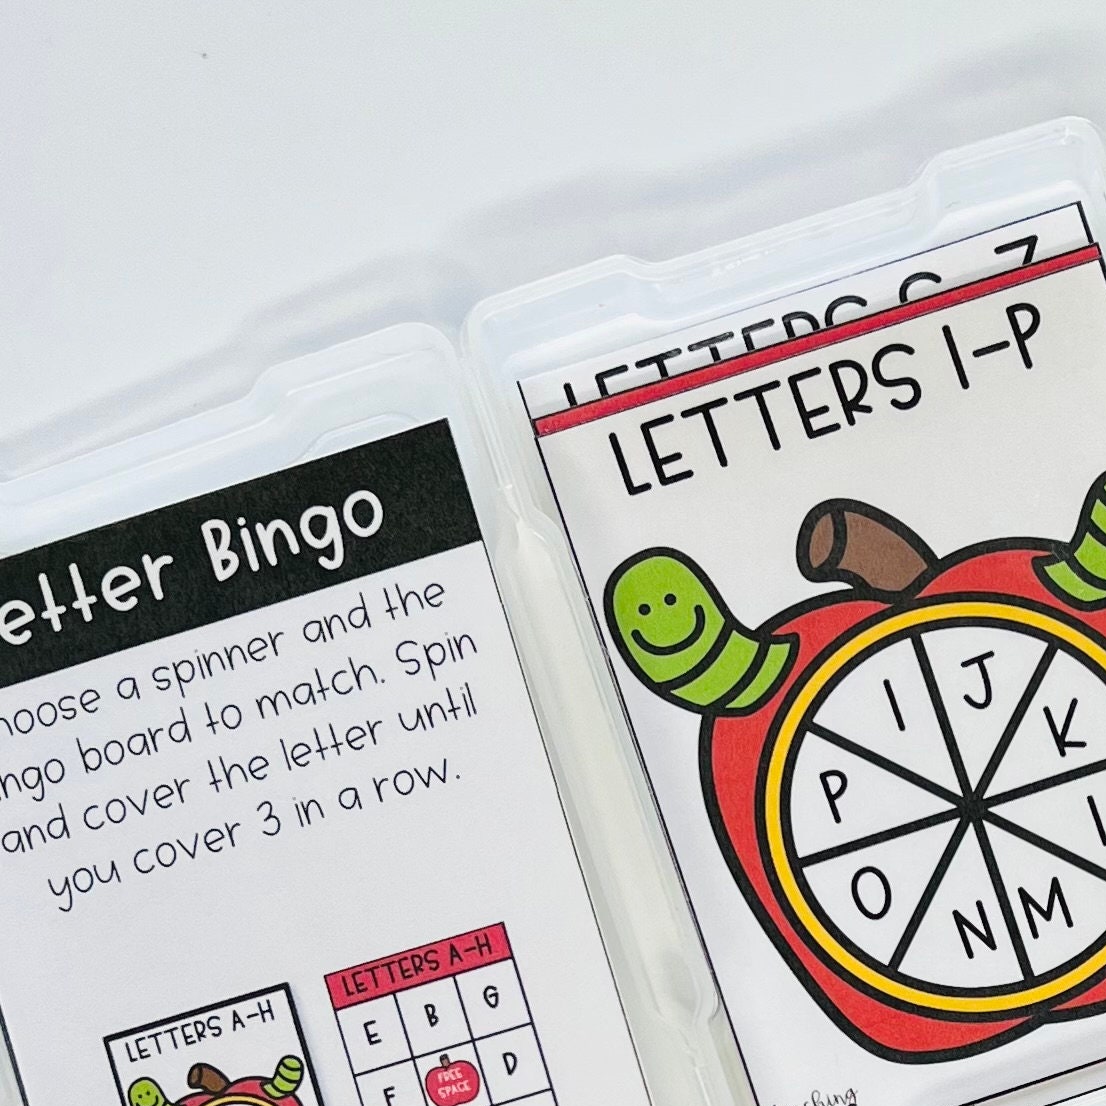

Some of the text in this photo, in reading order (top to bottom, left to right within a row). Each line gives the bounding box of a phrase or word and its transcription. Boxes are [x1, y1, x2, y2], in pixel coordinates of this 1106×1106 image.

[609, 343, 922, 497] LETTERS
[0, 489, 384, 645] etter Bingo
[117, 677, 141, 700] a
[152, 630, 285, 698] spinner
[303, 592, 372, 643] and
[384, 579, 445, 621] the
[884, 678, 906, 732] I
[960, 650, 995, 710] J
[0, 629, 478, 802] ngo board to match. Spin
[1043, 697, 1087, 758] K
[2, 682, 478, 853] and cover the letter until
[819, 769, 848, 824] P
[48, 757, 462, 913] you cover 3 in a row.
[850, 865, 892, 921] O
[1017, 876, 1074, 940] M
[952, 899, 998, 960] N
[342, 932, 493, 997] LETTERS A-H
[424, 1003, 439, 1029] B
[483, 985, 499, 1009] G
[125, 999, 275, 1063] LETTERS A-H
[364, 1020, 382, 1046] E
[437, 1080, 472, 1099] SPACE
[503, 1051, 518, 1076] D
